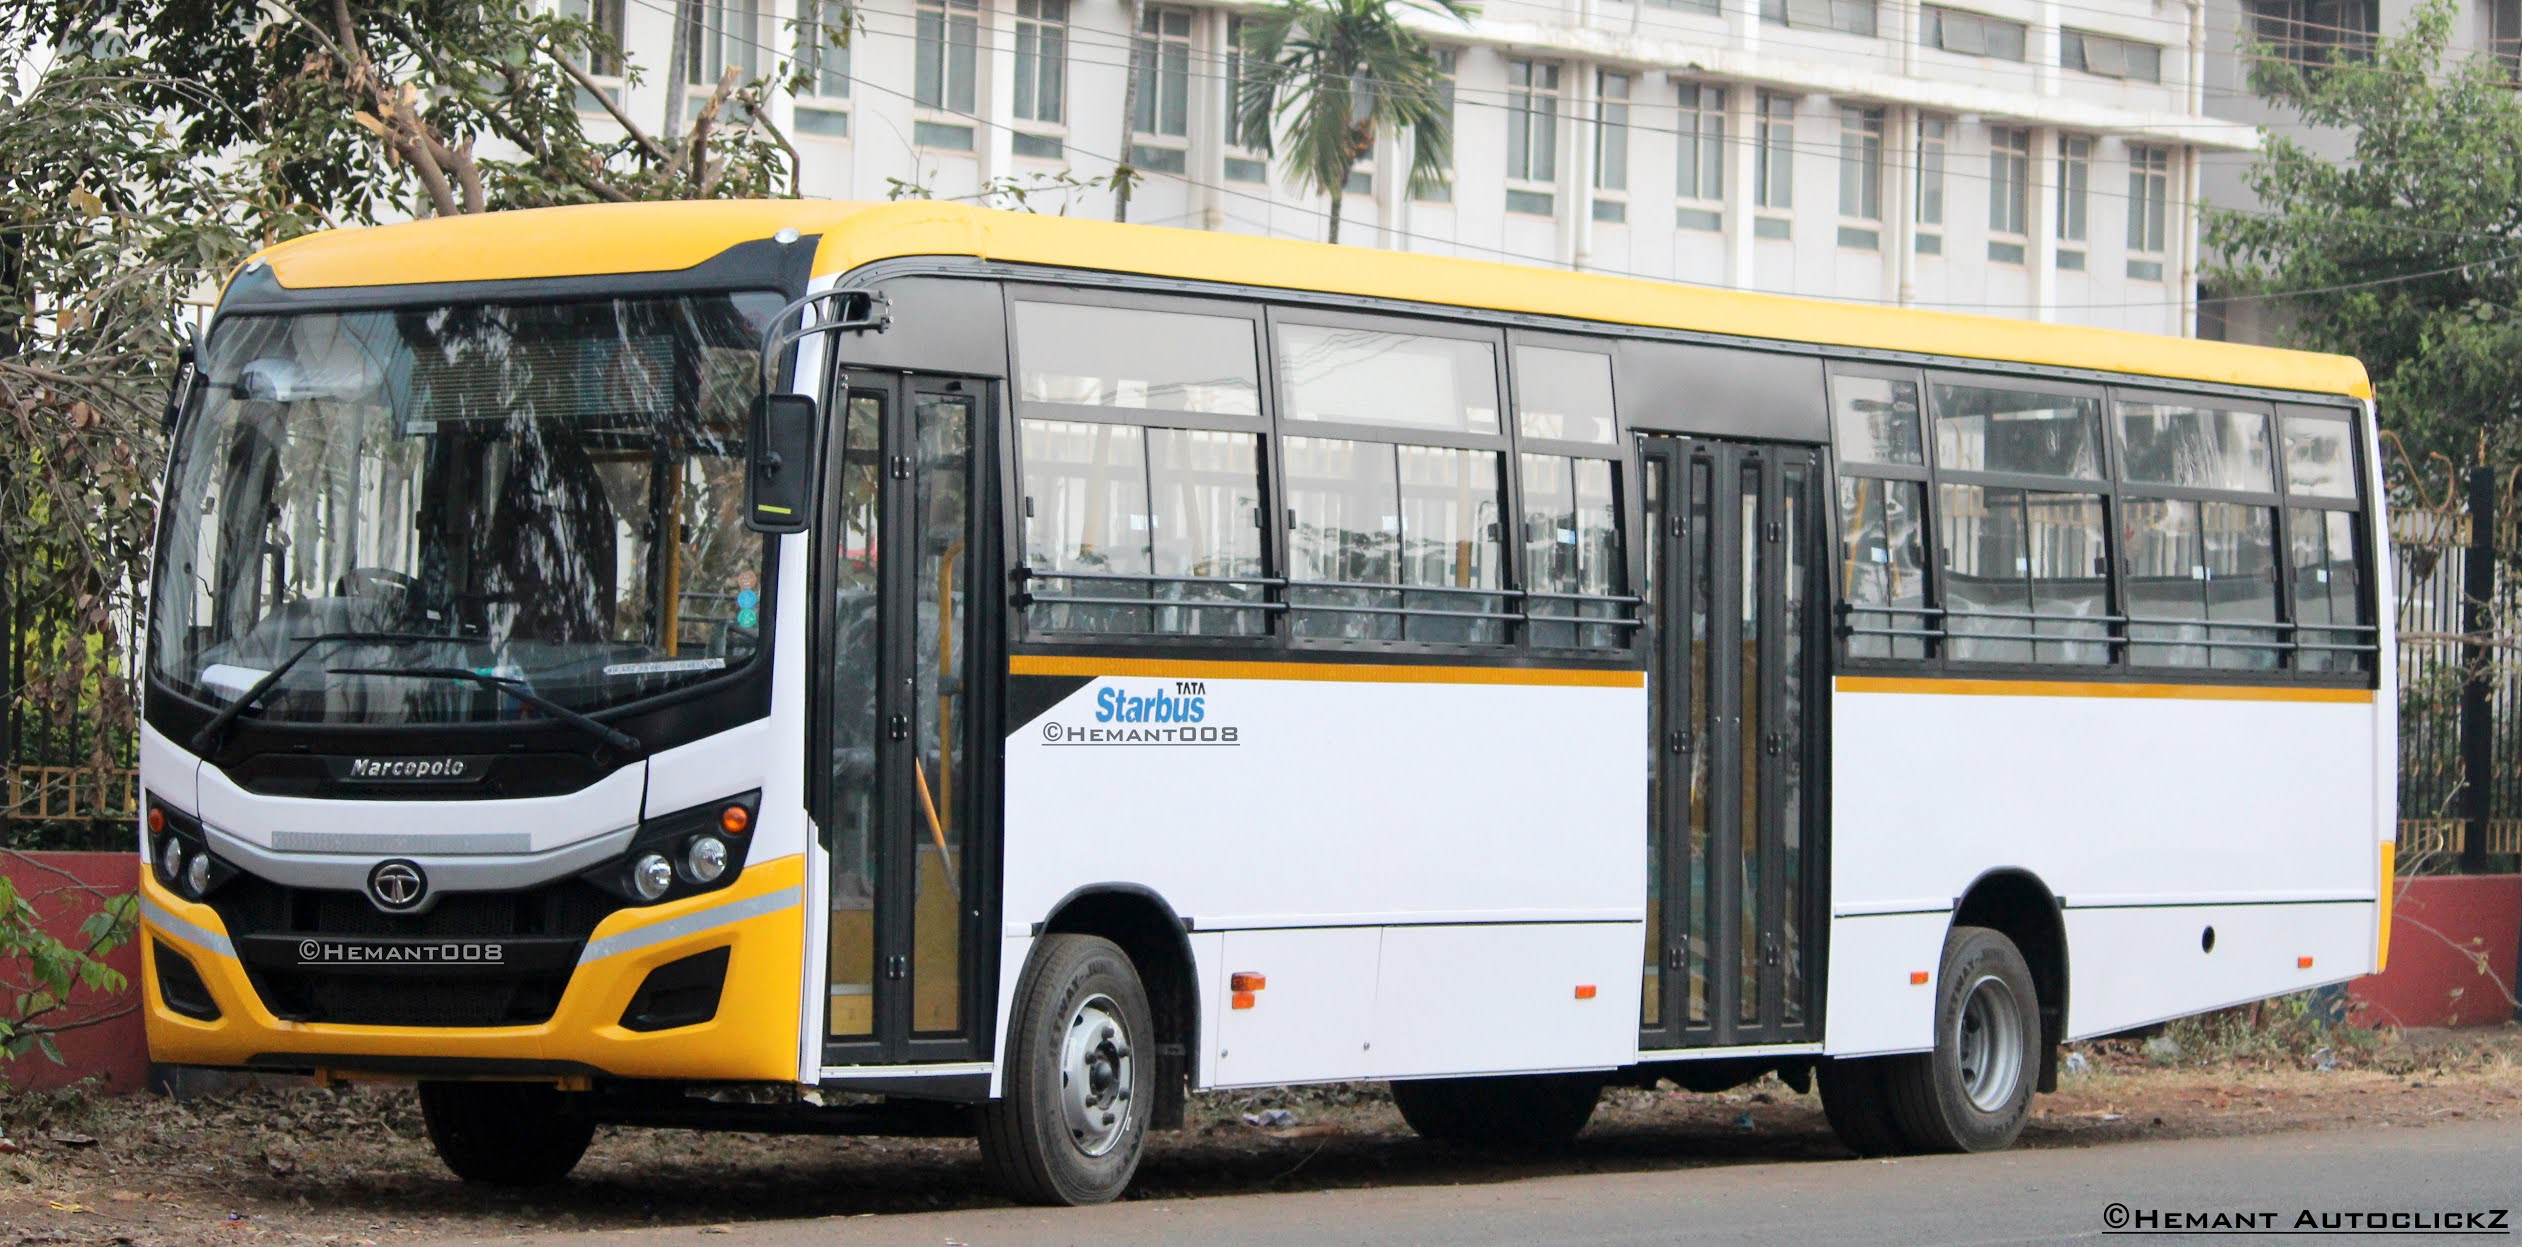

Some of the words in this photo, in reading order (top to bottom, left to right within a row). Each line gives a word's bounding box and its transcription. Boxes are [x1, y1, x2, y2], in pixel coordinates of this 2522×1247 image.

[1176, 682, 1206, 695] TATA
[1095, 686, 1206, 723] Starbus
[350, 758, 464, 777] Marcopolo
